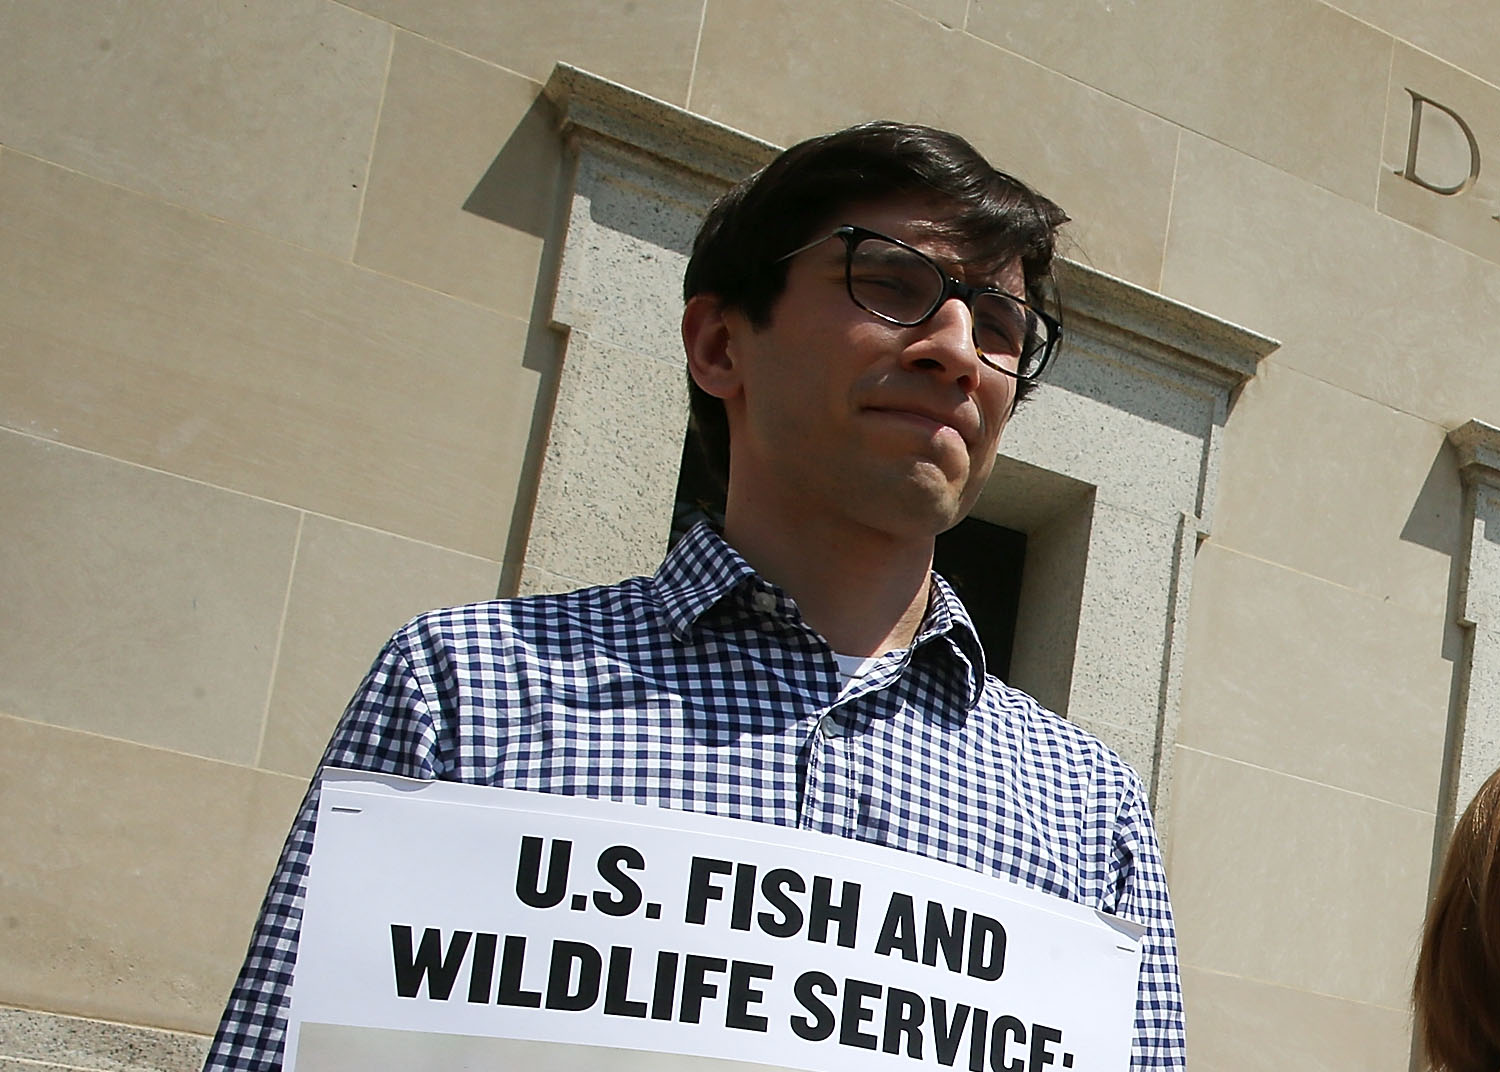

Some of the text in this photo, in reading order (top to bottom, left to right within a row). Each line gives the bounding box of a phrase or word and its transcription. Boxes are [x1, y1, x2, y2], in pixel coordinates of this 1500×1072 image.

[516, 835, 1007, 982] U.S. FISH AND
[391, 924, 773, 1033] WILDLIFE
